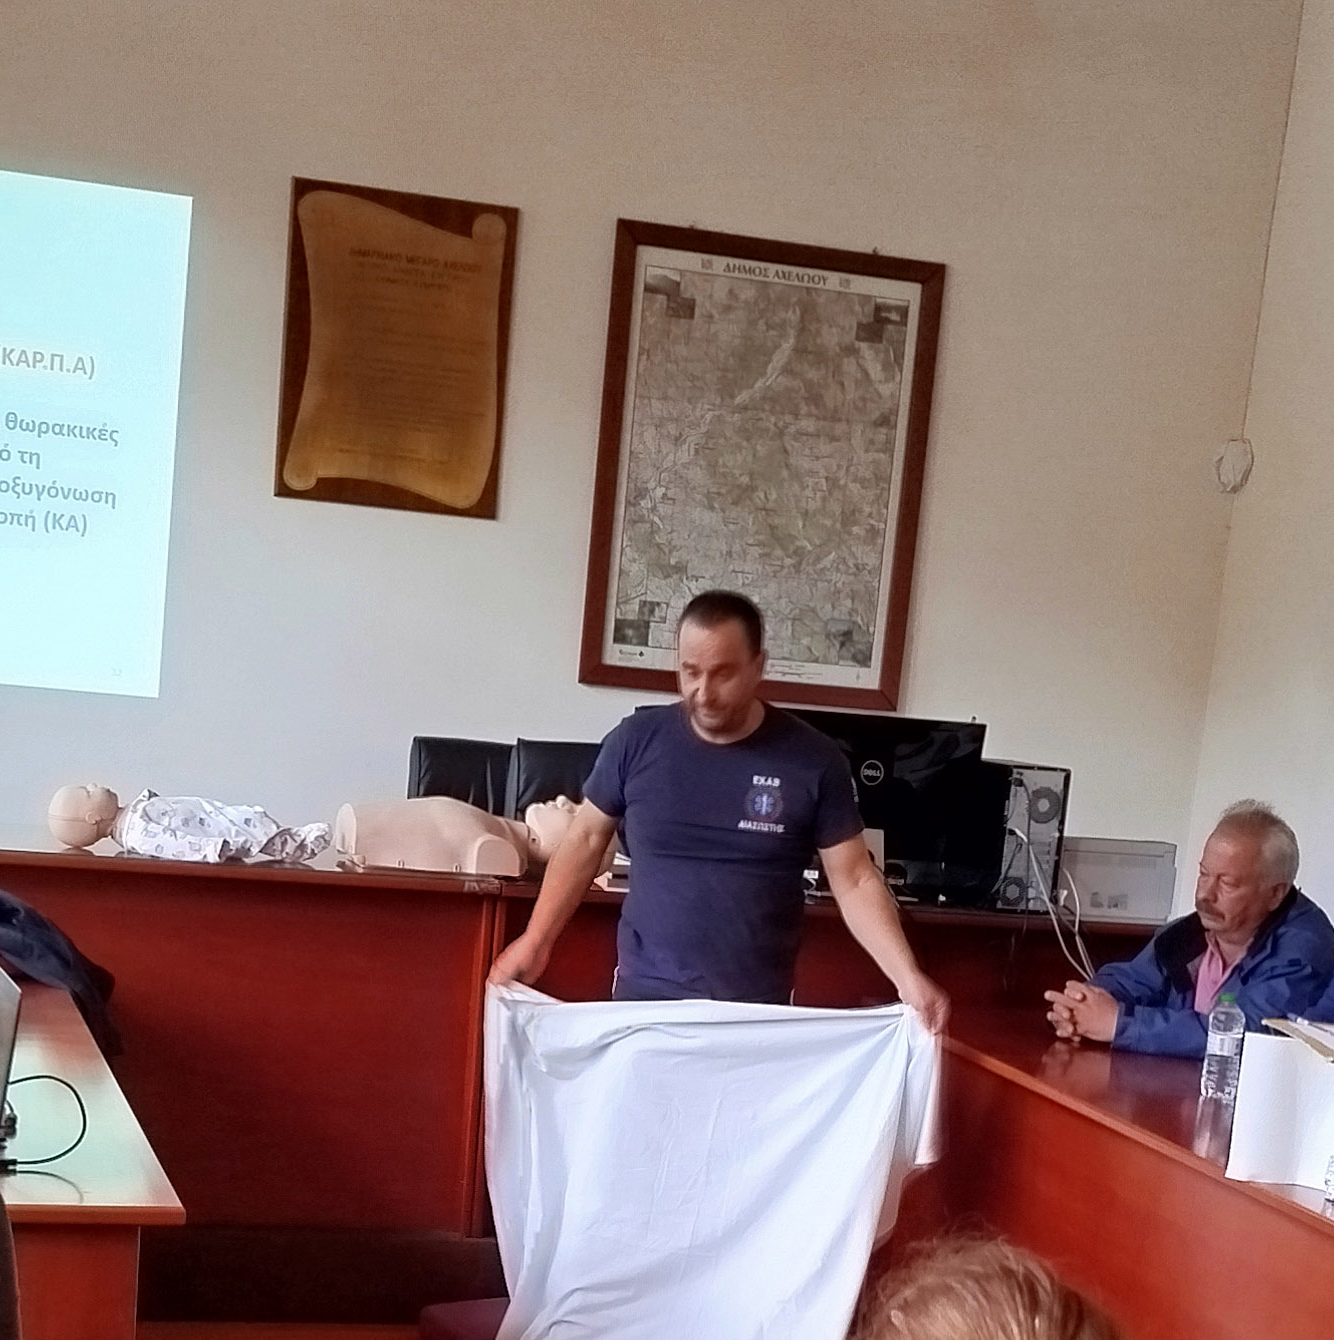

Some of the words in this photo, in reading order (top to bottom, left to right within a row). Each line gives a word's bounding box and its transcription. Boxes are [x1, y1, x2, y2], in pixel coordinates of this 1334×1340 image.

[723, 262, 770, 279] ΔΗΜΟΣ
[772, 269, 829, 286] ΑΧΕΛΩΟΥ
[4, 411, 119, 447] θωρακικές
[17, 449, 41, 469] τη
[43, 510, 88, 538] (ΚΑ)
